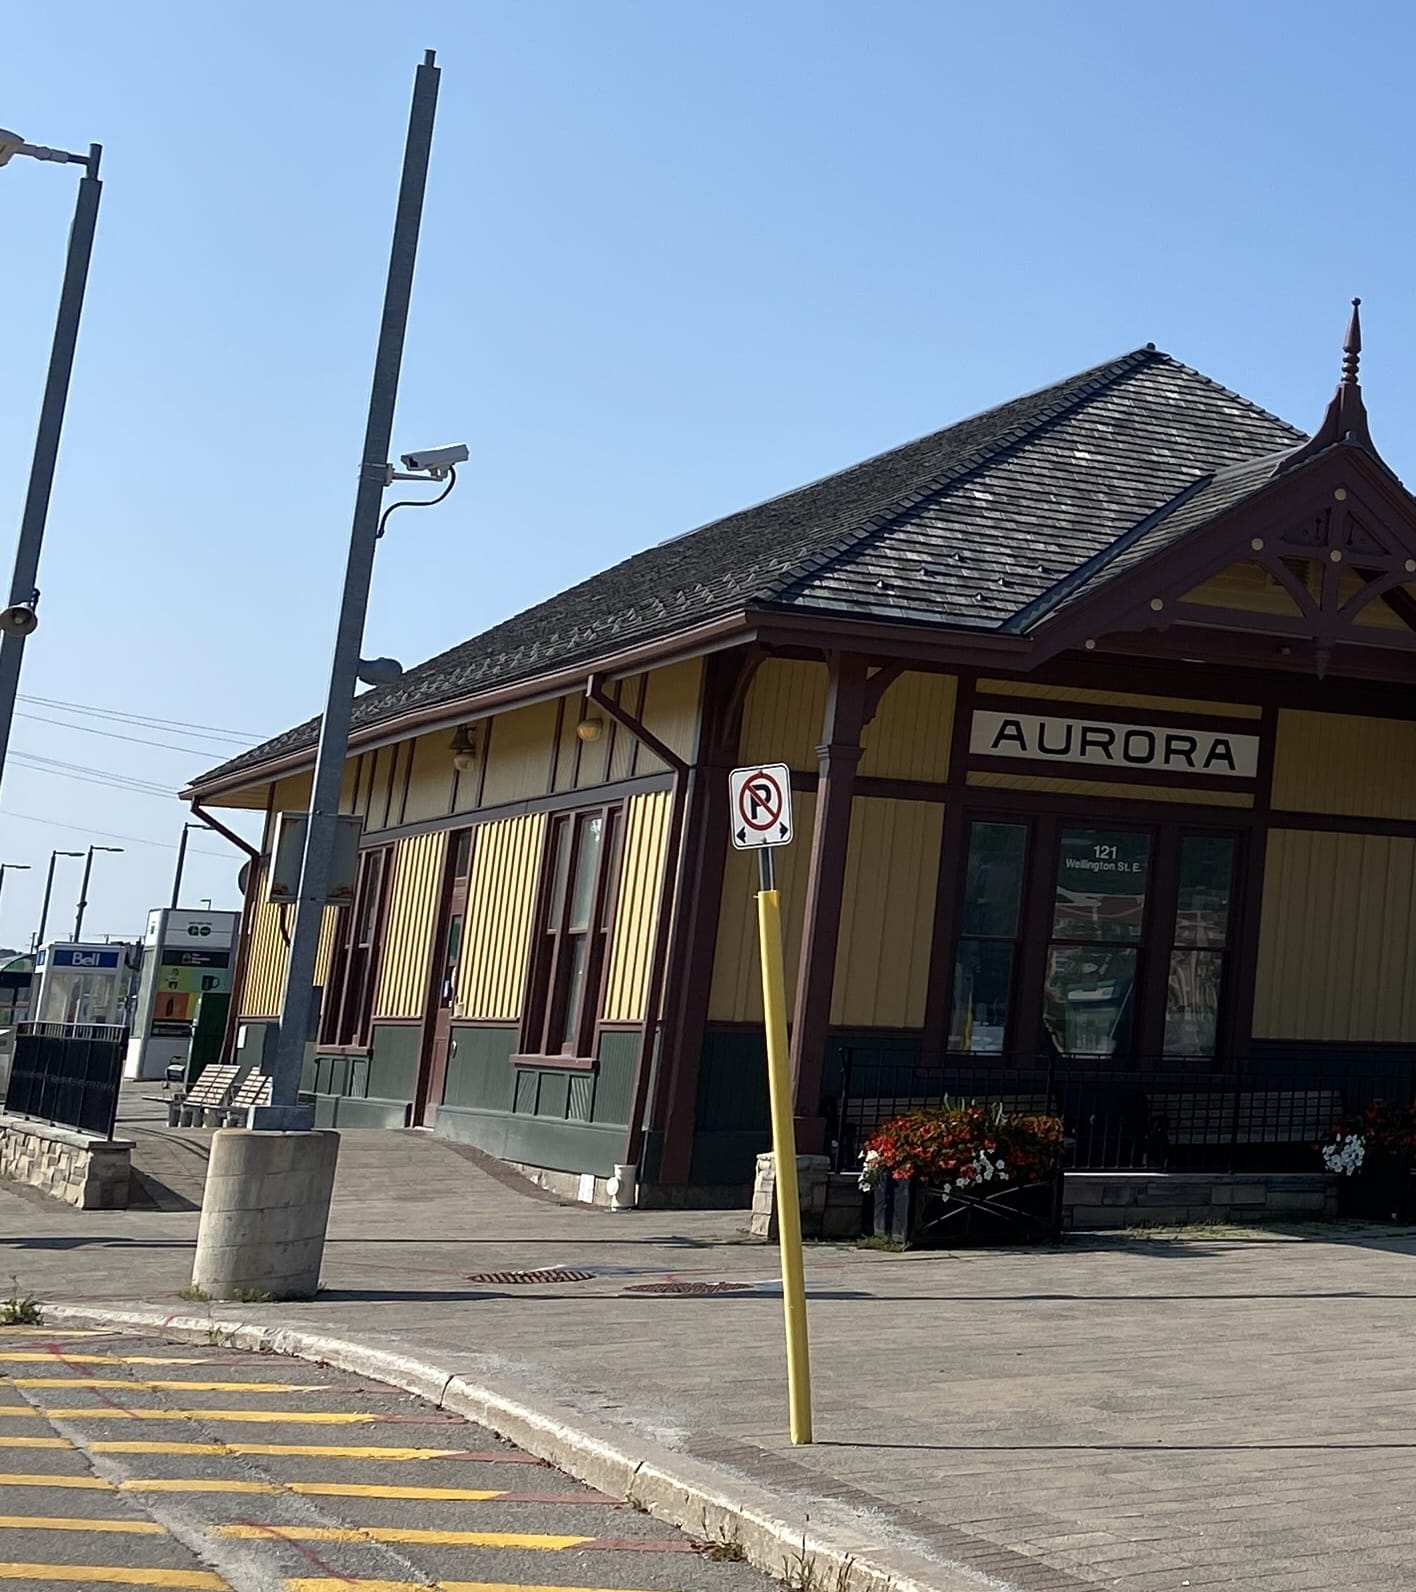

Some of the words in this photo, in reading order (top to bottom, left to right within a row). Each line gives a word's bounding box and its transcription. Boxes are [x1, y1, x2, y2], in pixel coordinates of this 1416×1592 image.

[991, 719, 1236, 771] AURORA
[750, 784, 772, 819] P
[1093, 845, 1117, 859] 121
[1065, 858, 1115, 872] Wellington
[72, 952, 100, 967] Bell
